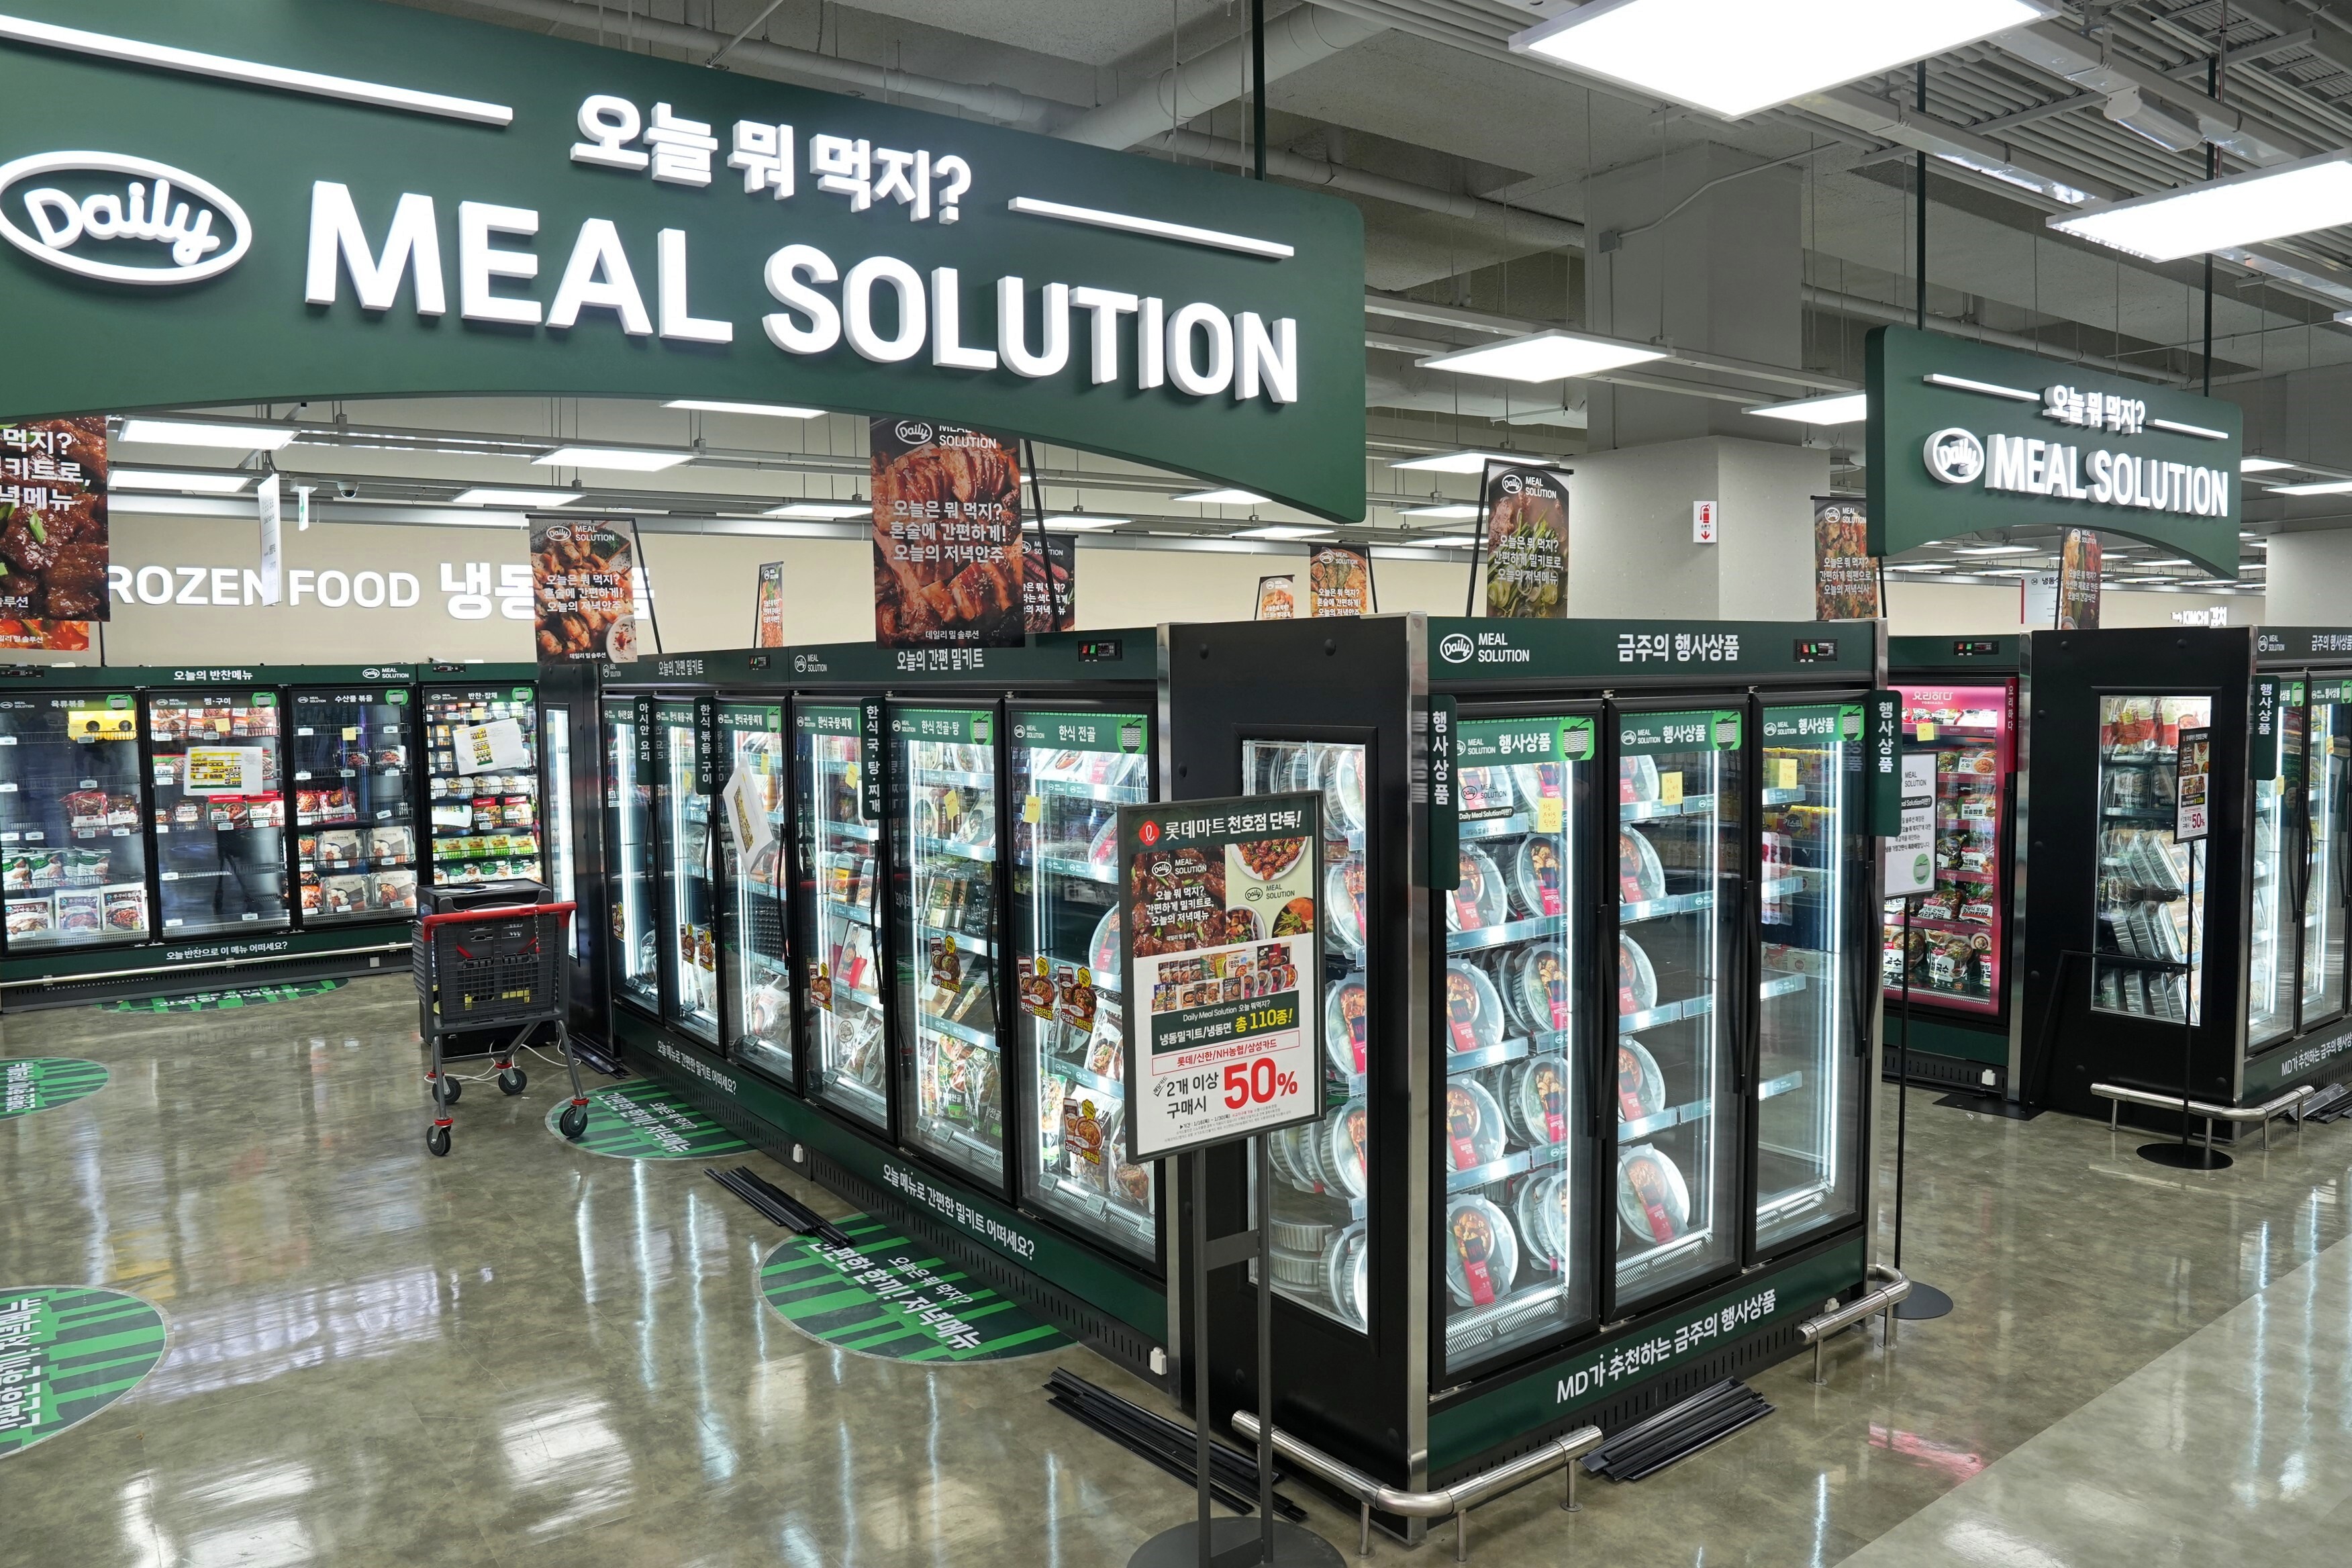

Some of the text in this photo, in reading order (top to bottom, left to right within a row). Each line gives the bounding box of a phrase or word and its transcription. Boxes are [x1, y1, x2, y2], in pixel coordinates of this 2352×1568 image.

[571, 95, 971, 225] 오늘 뭐 먹지?
[23, 179, 1297, 403] Daily MEAL SOLUTION
[2043, 385, 2145, 434] 오늘 뭐 먹지?
[900, 423, 929, 440] Daily
[3, 429, 72, 454] 먹지?
[940, 435, 996, 449] SOLUTION
[1526, 476, 1543, 487] MEAL
[1938, 434, 2228, 517] Daily MEAL SOLUTION
[1505, 479, 1520, 491] Daily
[1526, 487, 1557, 499] SOLUTION
[893, 501, 1003, 520] 오늘은 뭐 먹지?
[1843, 516, 1867, 524] SOLUTION
[575, 525, 597, 533] MEAL
[889, 522, 1006, 542] 혼술에 간편하게!
[1500, 535, 1559, 552] 오늘은 뭐 먹지?
[893, 544, 939, 562] 오늘의
[944, 546, 1005, 564] 저녁안주
[1493, 551, 1563, 571] 간편하게 밀키트로,
[1824, 558, 1843, 569] 오늘은
[1852, 557, 1869, 569] 먹지?
[546, 574, 578, 585] 오늘은
[593, 575, 620, 585] 먹지?
[1498, 568, 1559, 585] 오늘의 저녁메뉴
[289, 569, 420, 608] FOOD
[544, 588, 624, 599] 혼술에 간편하게!
[1824, 585, 1843, 595] 오늘의
[547, 601, 622, 613] 오늘의 저녁안주
[2183, 610, 2209, 625] KIMCHI
[926, 630, 979, 640] 데일리 밀 솔루션
[1477, 632, 1508, 646] MEAL
[1444, 639, 1471, 658] Daily
[1478, 648, 1530, 663] SOLUTION
[1618, 634, 1740, 663] 금주의 행사상품
[807, 654, 818, 663] MEAL
[897, 648, 984, 672] 오늘의 간편 밀키트
[174, 670, 253, 681] 오늘의 반찬메뉴
[658, 659, 703, 677] 오늘의 간편 밀키트
[807, 663, 828, 673] SOLUTION
[1913, 691, 1953, 701] 요리하다
[2258, 683, 2273, 735] 행사상품
[639, 703, 650, 761] 아시안 요리
[921, 720, 960, 736] 한식 전골·탕
[1059, 725, 1096, 743] 한식 전골
[1663, 724, 1706, 744] 행사상품
[1798, 717, 1834, 734] 행사상품
[700, 704, 713, 785] 한식 볶음·구이
[1499, 732, 1552, 754] 행사상품
[1878, 701, 1894, 773] 행사상품
[1432, 710, 1450, 805] 행사상품
[1467, 746, 1496, 755] SOLUTION
[1904, 771, 1917, 779] MEAL
[1904, 779, 1927, 788] SOLUTION
[1480, 791, 1507, 799] SOLUTION
[1165, 810, 1302, 841] 롯데마트 천호점 단독!
[2192, 813, 2205, 829] 50%
[1153, 863, 1170, 875] Daily
[1175, 865, 1207, 875] SOLUTION
[1156, 885, 1204, 901] 오늘 뭐 먹지?
[1246, 889, 1261, 899] Daily
[1266, 890, 1295, 899] SOLUTION
[1146, 898, 1214, 915] 간편하게 밀키트로,
[1151, 910, 1210, 927] 오늘의 저녁메뉴
[166, 941, 288, 960] 오늘 반찬으로 이 메뉴 어떠세요?
[1183, 1012, 1197, 1022] Daily
[1199, 1010, 1214, 1018] Meal
[1214, 1007, 1237, 1018] Solution
[1238, 1004, 1249, 1012] 오늘
[1160, 1008, 1293, 1046] 냉동밀키트/냉동면 총 110종!
[1177, 1039, 1277, 1067] 롯데/신한/NH농협/삼성카드
[1153, 1076, 1168, 1094] 해당카드
[1167, 1058, 1298, 1110] 2개 이상 50%
[1167, 1096, 1207, 1120] 구매시
[883, 1164, 1035, 1261] 오늘 메뉴로 간편한 밀키트 어떠세요?
[888, 1257, 930, 1279] 오늘은
[935, 1283, 973, 1305] 먹지?
[852, 1268, 916, 1300] 한끼!
[899, 1296, 981, 1349] 저녁메뉴
[1557, 1289, 1776, 1404] MD가 추천하는 금주의 행사상품
